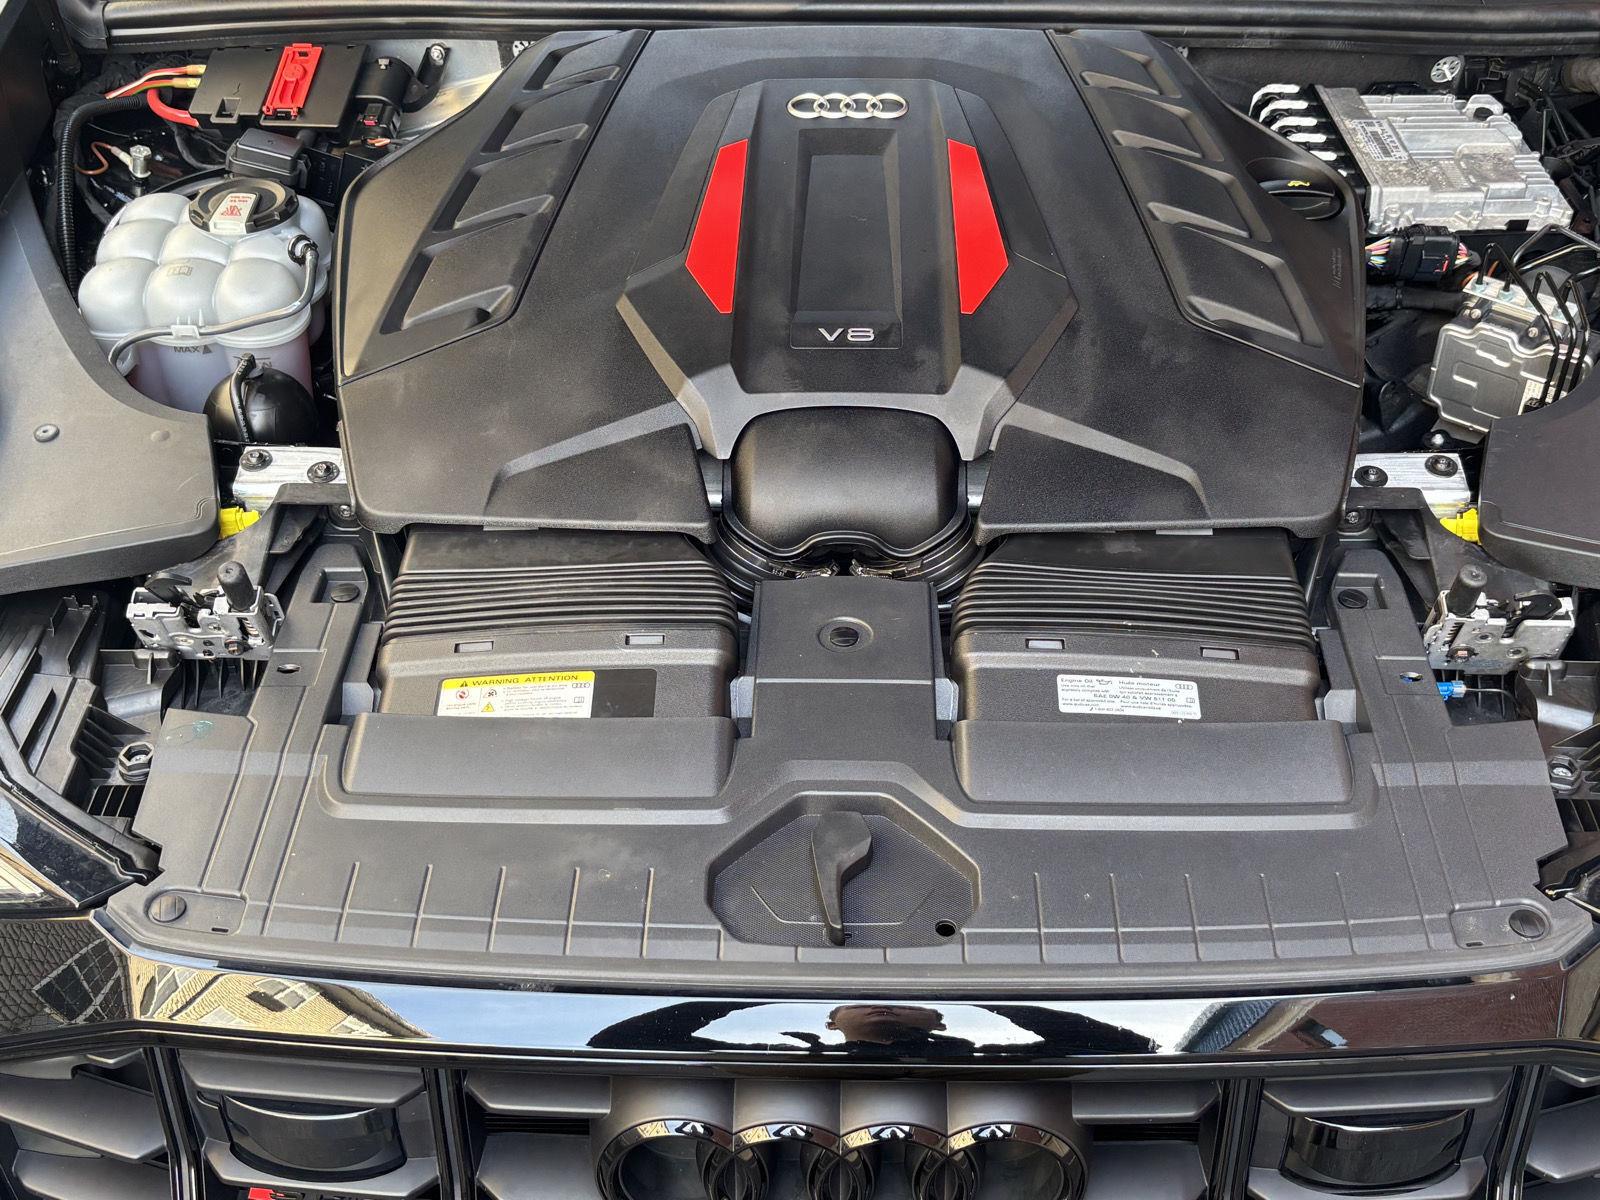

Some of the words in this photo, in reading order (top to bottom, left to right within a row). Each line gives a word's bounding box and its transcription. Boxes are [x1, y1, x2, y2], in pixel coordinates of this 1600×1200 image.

[818, 327, 875, 342] V8
[173, 345, 200, 353] MAX
[472, 677, 519, 686] WARNING
[525, 675, 579, 683] ATTENTION
